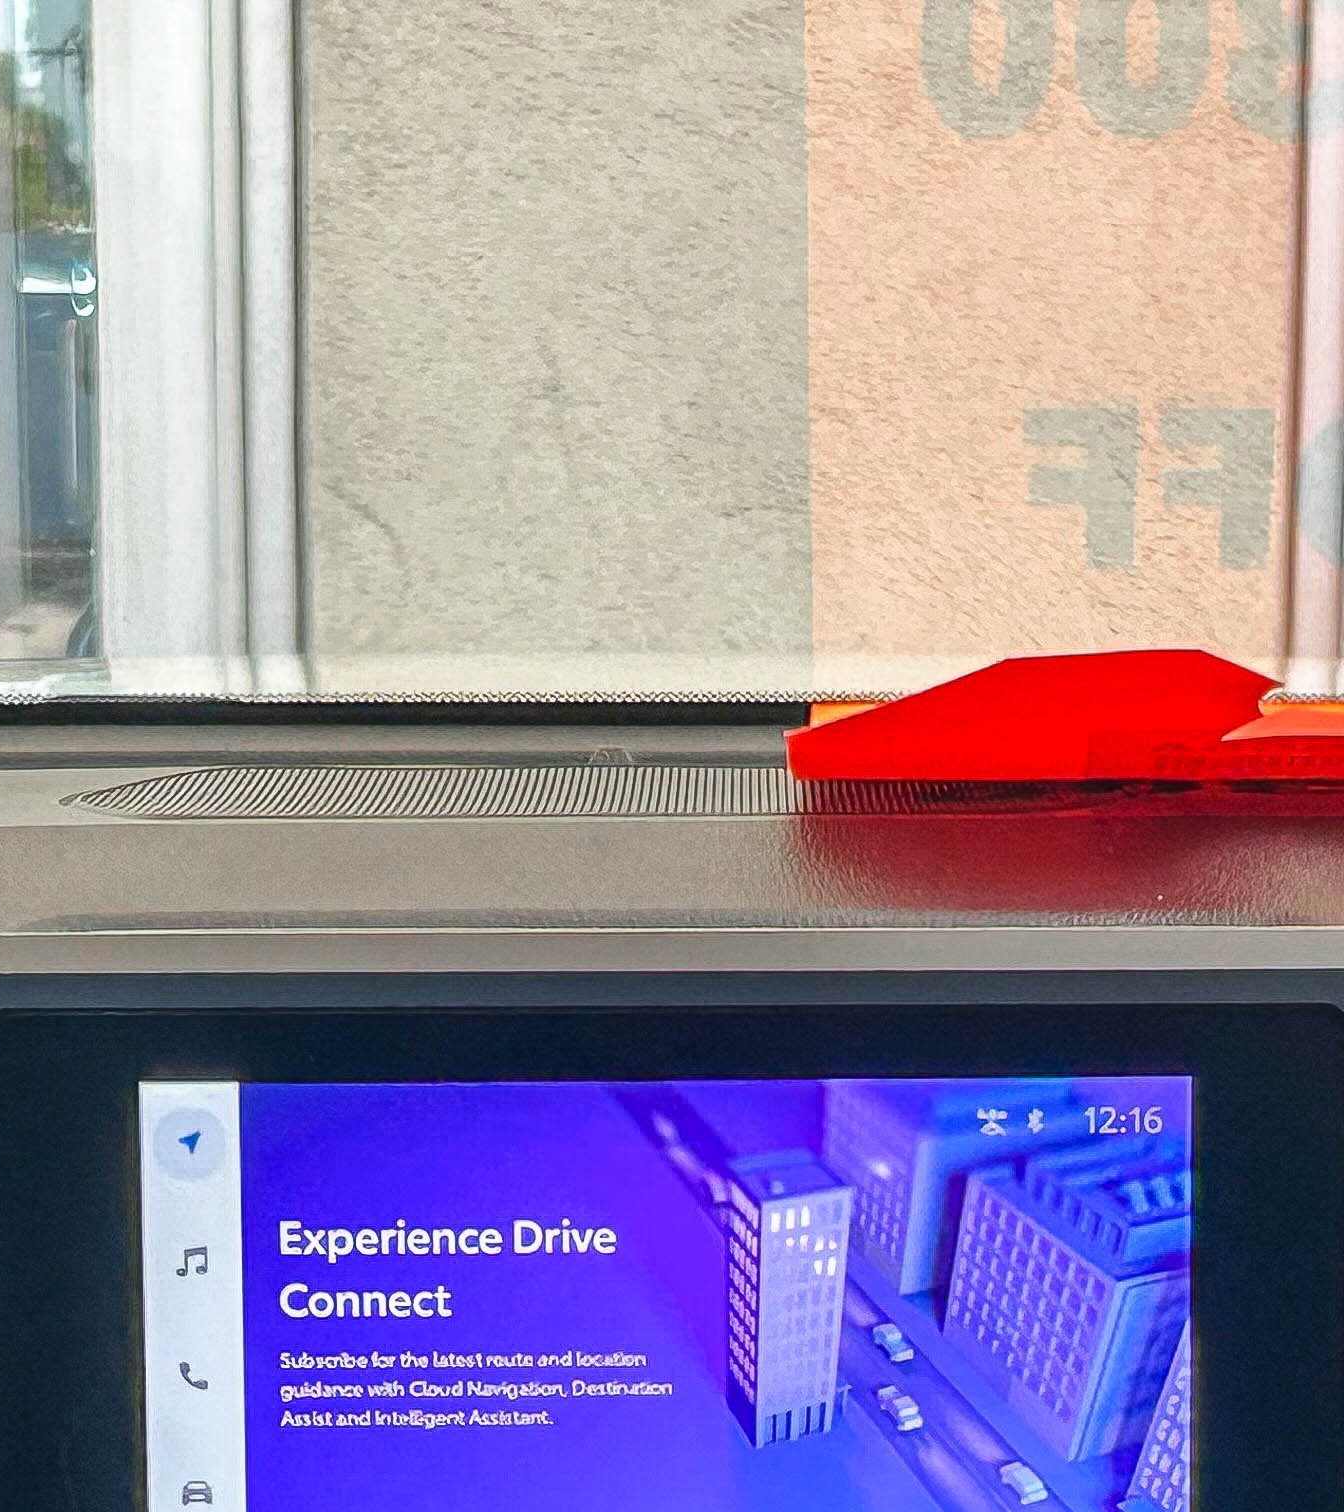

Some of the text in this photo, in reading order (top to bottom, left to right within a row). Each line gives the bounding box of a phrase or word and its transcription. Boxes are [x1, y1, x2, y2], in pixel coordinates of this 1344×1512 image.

[1084, 1106, 1163, 1134] 12:16
[279, 1218, 617, 1263] Experience Drive
[279, 1282, 453, 1318] Connect
[280, 1350, 647, 1369] Subscribe for the latest route and location
[280, 1380, 363, 1402] guidance
[367, 1380, 405, 1397] with
[409, 1380, 463, 1397] Cloud
[571, 1379, 673, 1397] Destination
[280, 1409, 333, 1427] Assist
[336, 1409, 371, 1426] and
[375, 1409, 466, 1429] Intelligent
